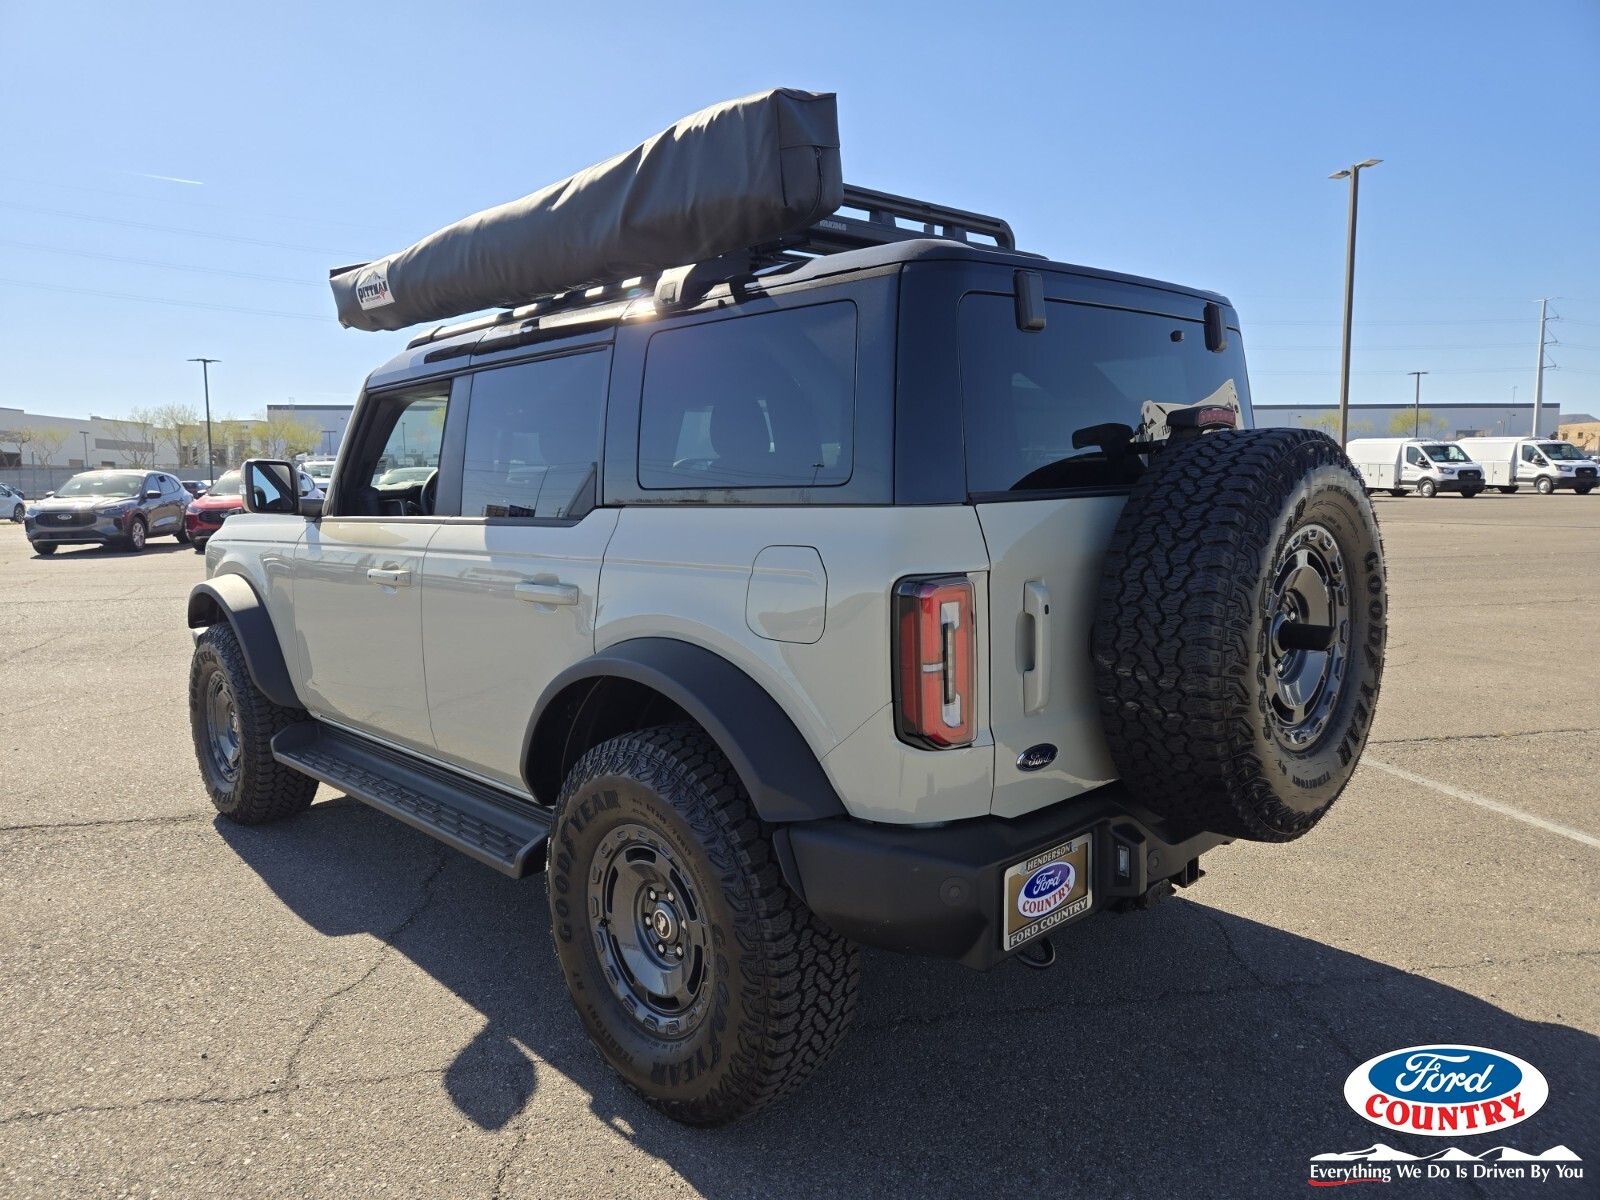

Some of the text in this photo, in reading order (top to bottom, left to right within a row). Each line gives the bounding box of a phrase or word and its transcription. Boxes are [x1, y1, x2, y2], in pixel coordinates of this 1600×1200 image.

[358, 281, 388, 303] PITTMAN
[555, 790, 621, 944] GOODYEAR
[1027, 842, 1072, 870] HENDERSON
[1022, 879, 1072, 913] COUNTRY
[1033, 868, 1062, 895] Ford
[1010, 898, 1088, 946] FORD COUNTRY
